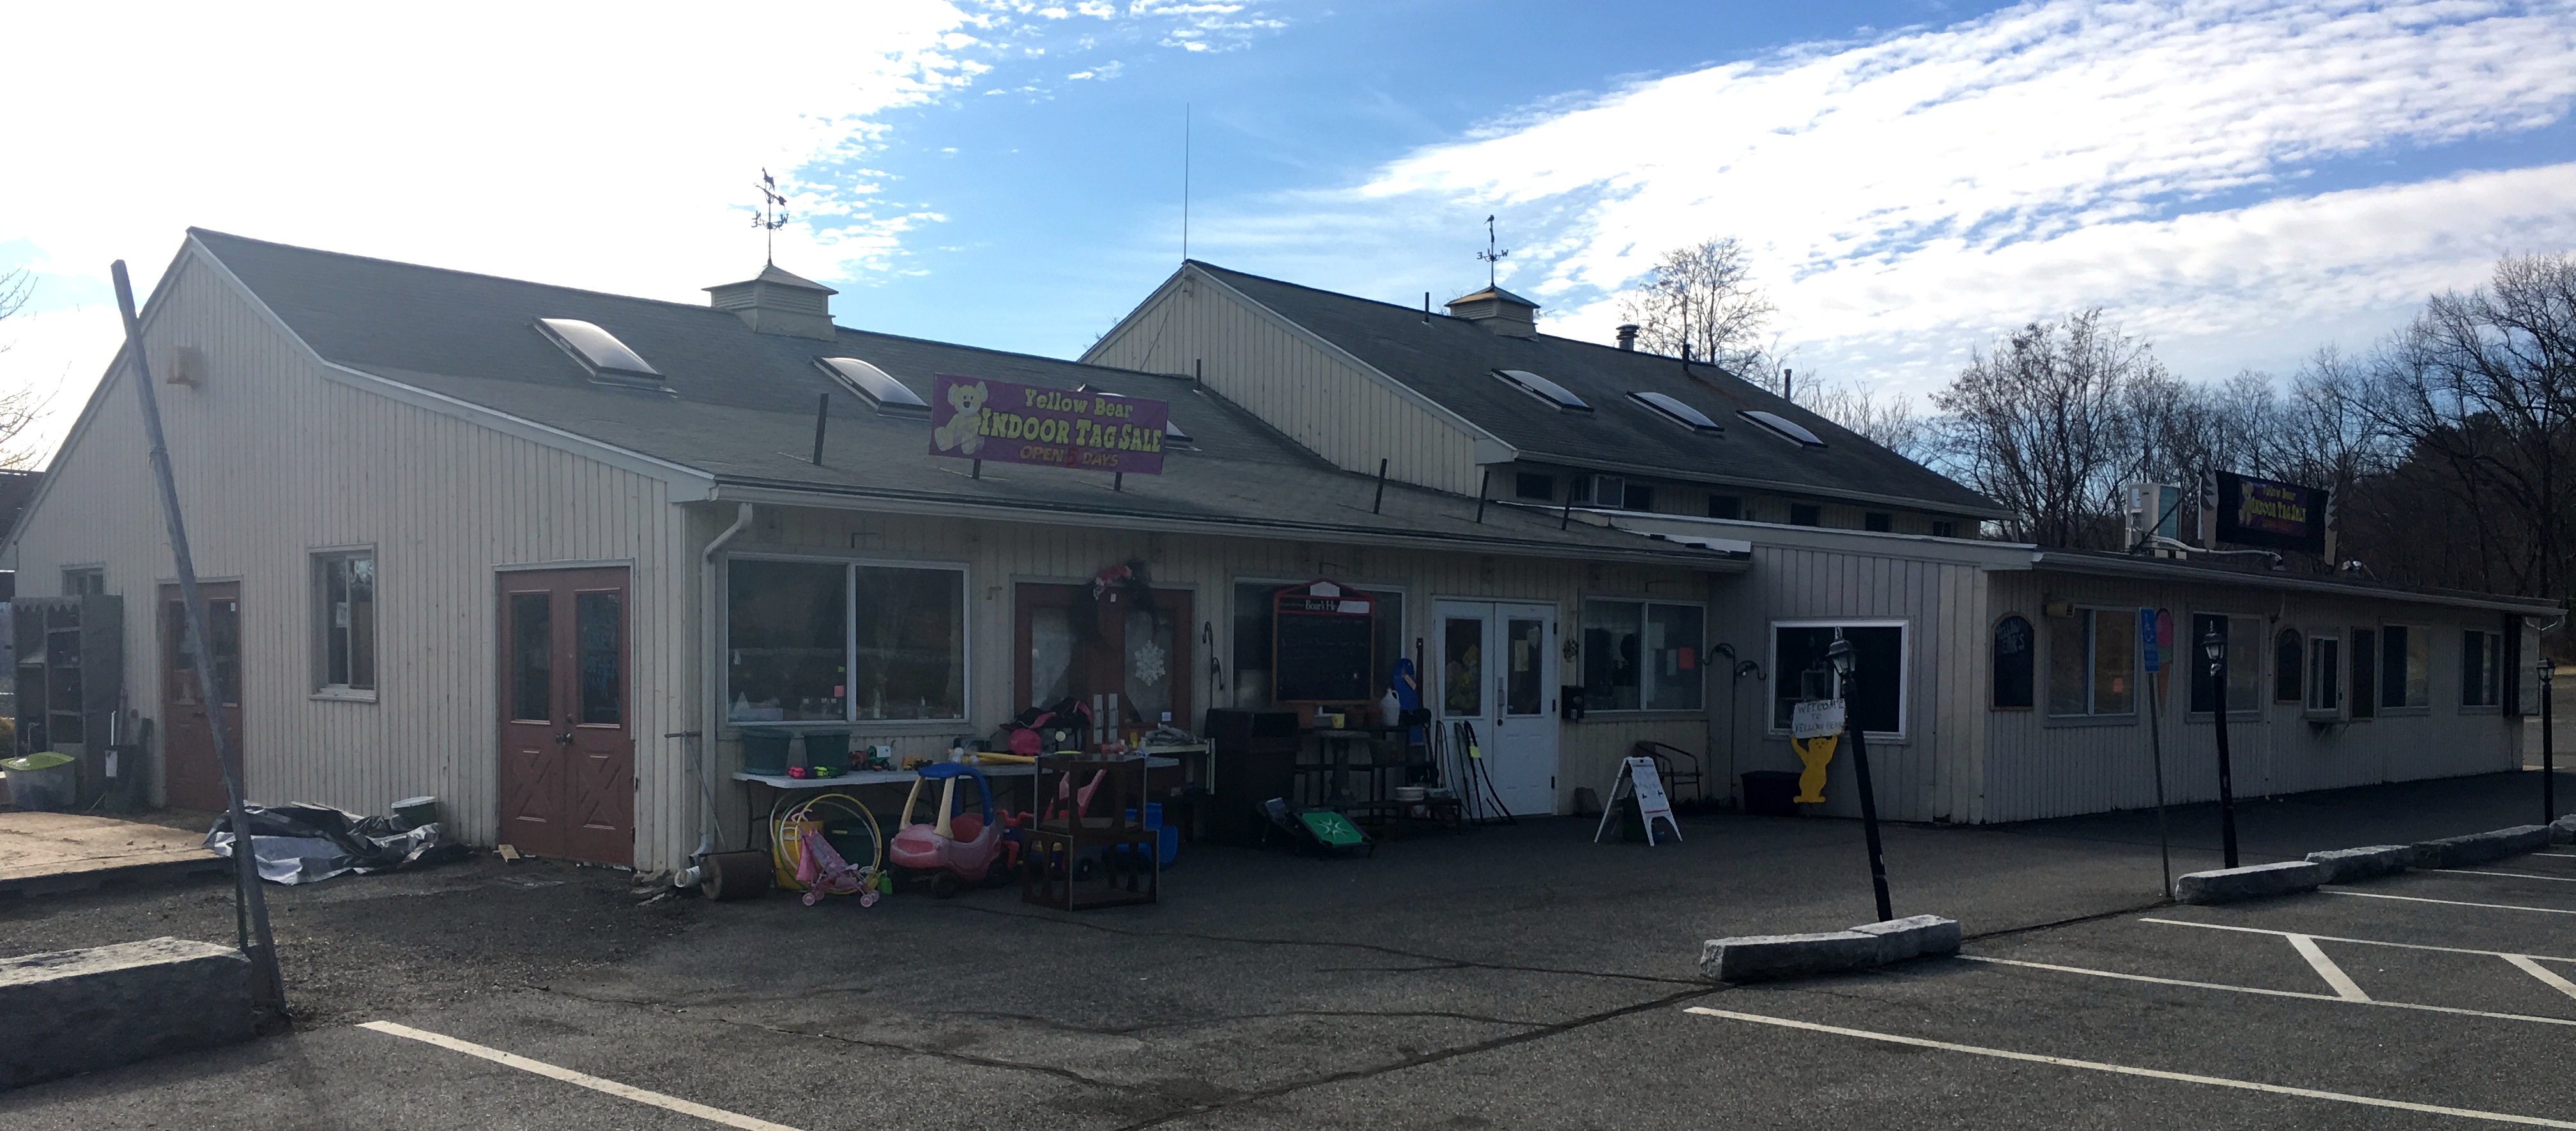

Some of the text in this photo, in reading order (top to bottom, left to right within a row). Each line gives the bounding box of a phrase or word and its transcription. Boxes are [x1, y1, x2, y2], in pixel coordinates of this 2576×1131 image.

[1025, 388, 1133, 418] Yellow Bear
[979, 408, 1162, 452] INDOOR TAG SALE
[1020, 445, 1064, 462] OPEN
[1082, 451, 1118, 467] DAYS
[1798, 699, 1844, 713] WELCOME
